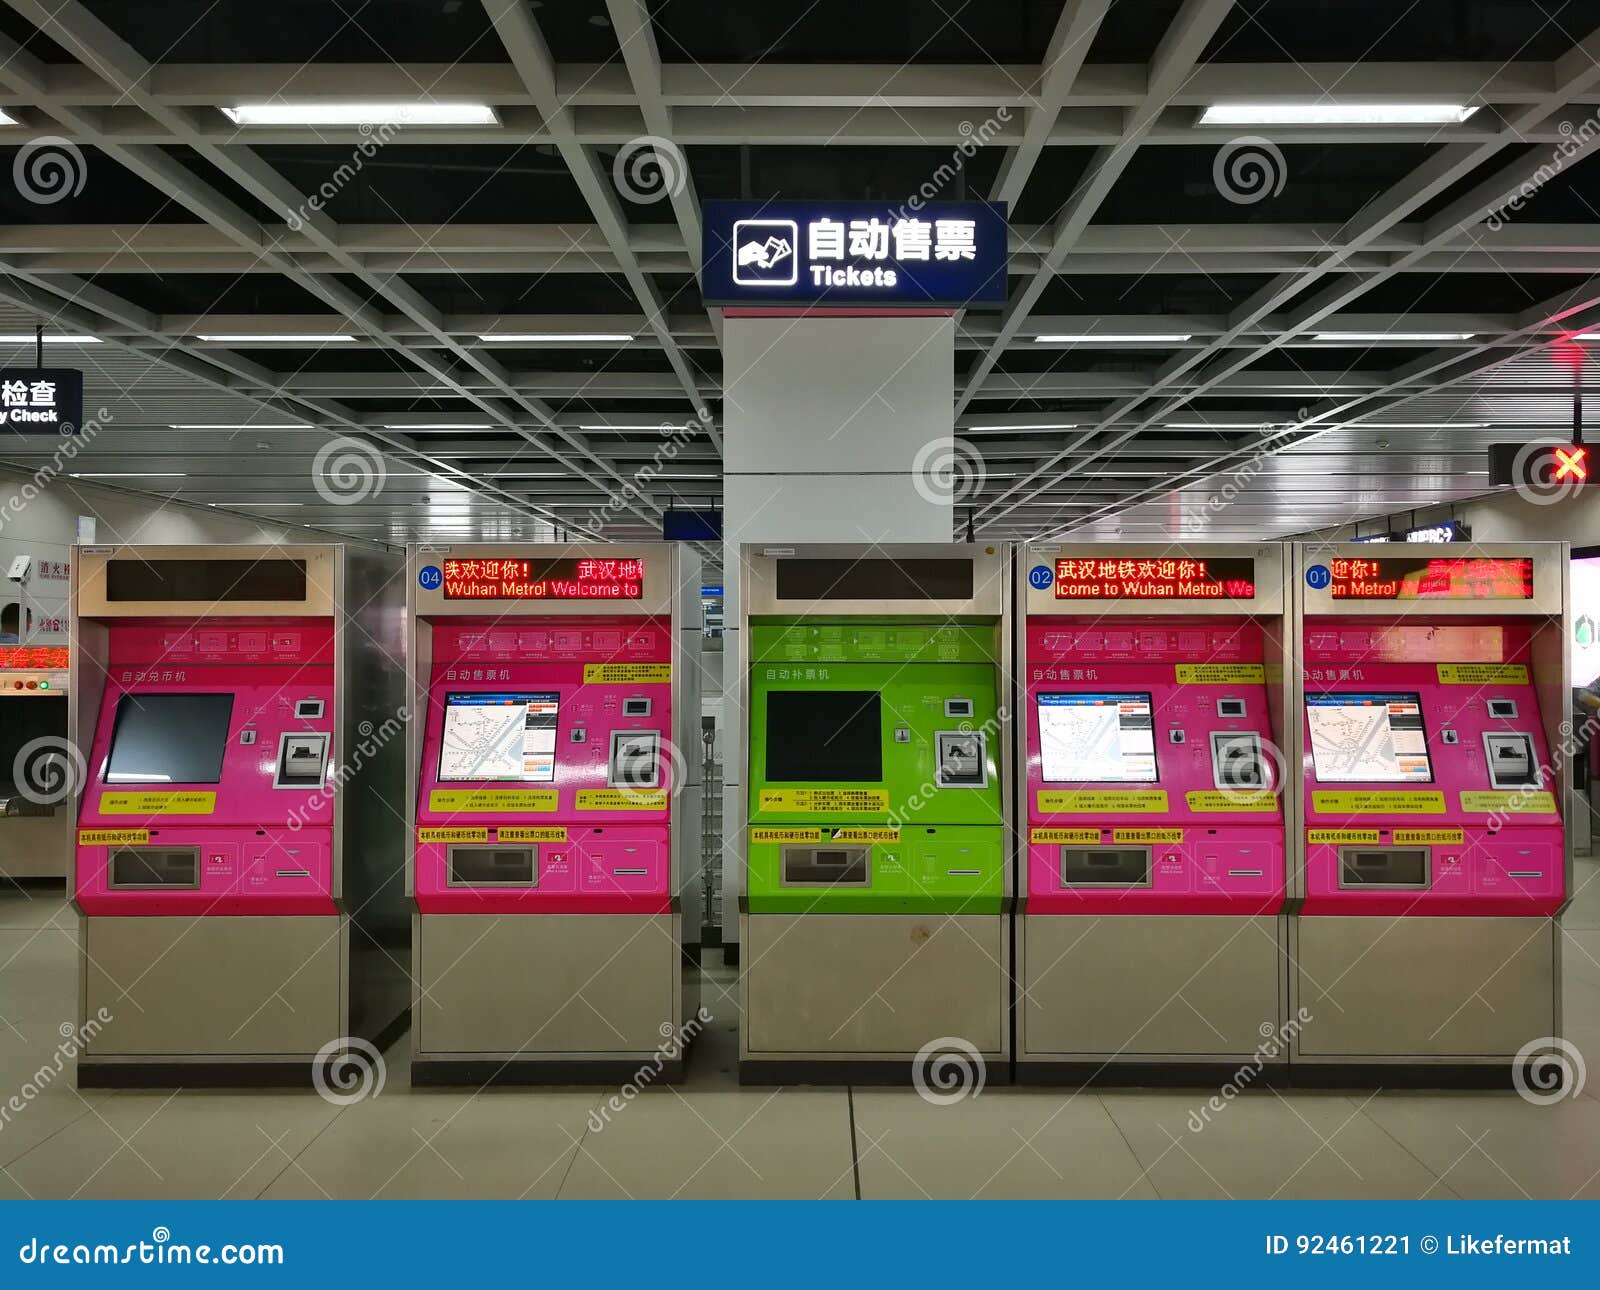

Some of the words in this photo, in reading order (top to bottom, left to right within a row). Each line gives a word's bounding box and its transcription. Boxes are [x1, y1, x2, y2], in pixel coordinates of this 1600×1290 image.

[809, 218, 976, 261] 自动售票
[810, 266, 897, 286] Tickets
[2, 380, 57, 407] 检查
[10, 409, 58, 422] Check
[579, 561, 643, 579] 武汉地
[1058, 561, 1205, 580] 武汉地铁欢迎你!
[421, 573, 440, 584] 04
[1032, 571, 1051, 584] 02
[1310, 571, 1327, 583] 01
[446, 581, 497, 596] Wuhan
[502, 581, 547, 596] Metro!
[551, 582, 620, 596] Welcome
[624, 583, 639, 596] to
[1104, 583, 1119, 596] to
[1122, 582, 1173, 596] Wuhan
[1178, 582, 1223, 596] Metro!
[1351, 581, 1397, 595] Metro!
[121, 671, 187, 683] 自动兑币机
[447, 669, 511, 681] 自动售票机
[766, 669, 830, 680] 自动补票机
[1033, 669, 1099, 681] 自动售票机
